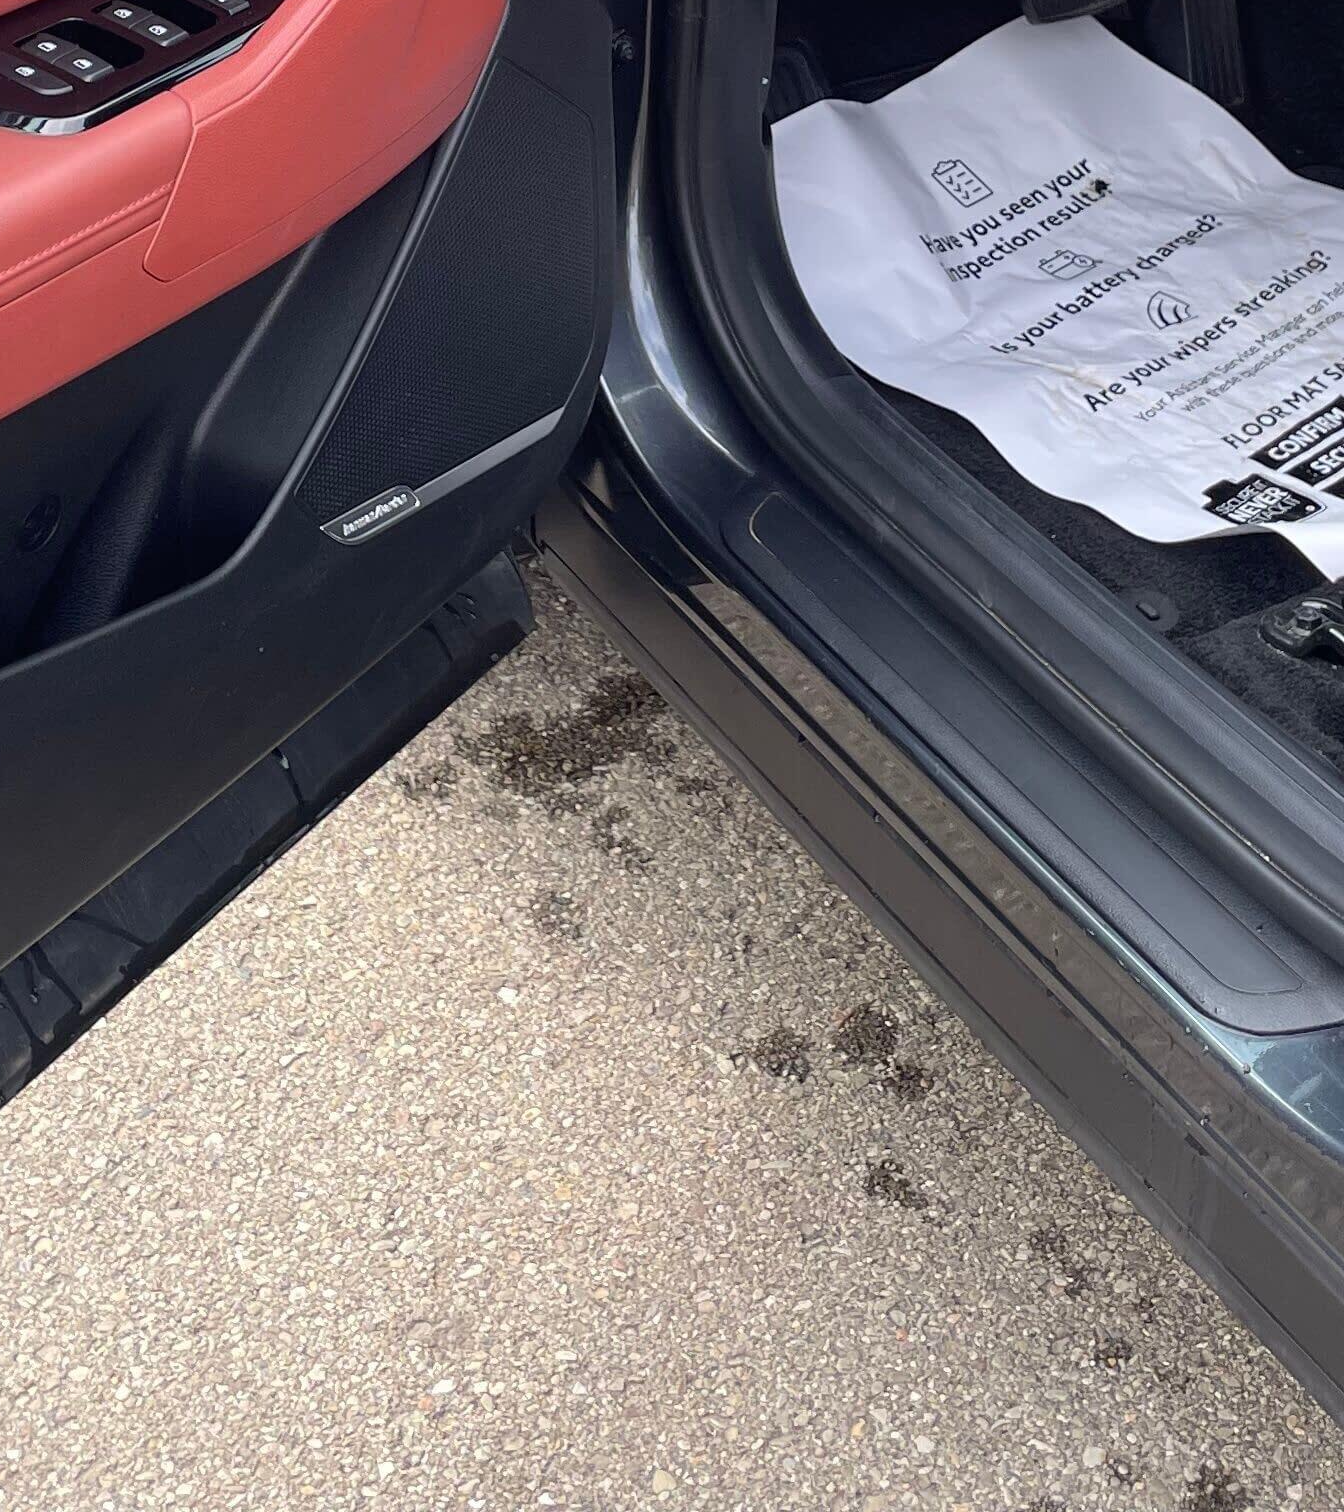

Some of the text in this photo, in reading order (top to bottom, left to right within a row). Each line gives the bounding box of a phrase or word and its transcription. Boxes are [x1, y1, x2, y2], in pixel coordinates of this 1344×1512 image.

[919, 157, 1092, 256] Have you seen your
[989, 213, 1224, 355] Is your battery charged?
[1083, 248, 1333, 413] Are your wipers streaking?
[1133, 398, 1168, 423] Your
[1167, 366, 1222, 402] Assistant
[1214, 343, 1261, 376] Service
[1254, 312, 1306, 348] Manager
[1305, 296, 1330, 316] can
[1181, 392, 1210, 413] with
[1206, 374, 1244, 399] these
[1240, 340, 1297, 380] questions
[1294, 326, 1319, 346] and
[1221, 404, 1293, 450] FLOOR
[1282, 375, 1329, 411] MAT
[1215, 484, 1260, 515] SECURE
[1227, 486, 1289, 523] NEVER
